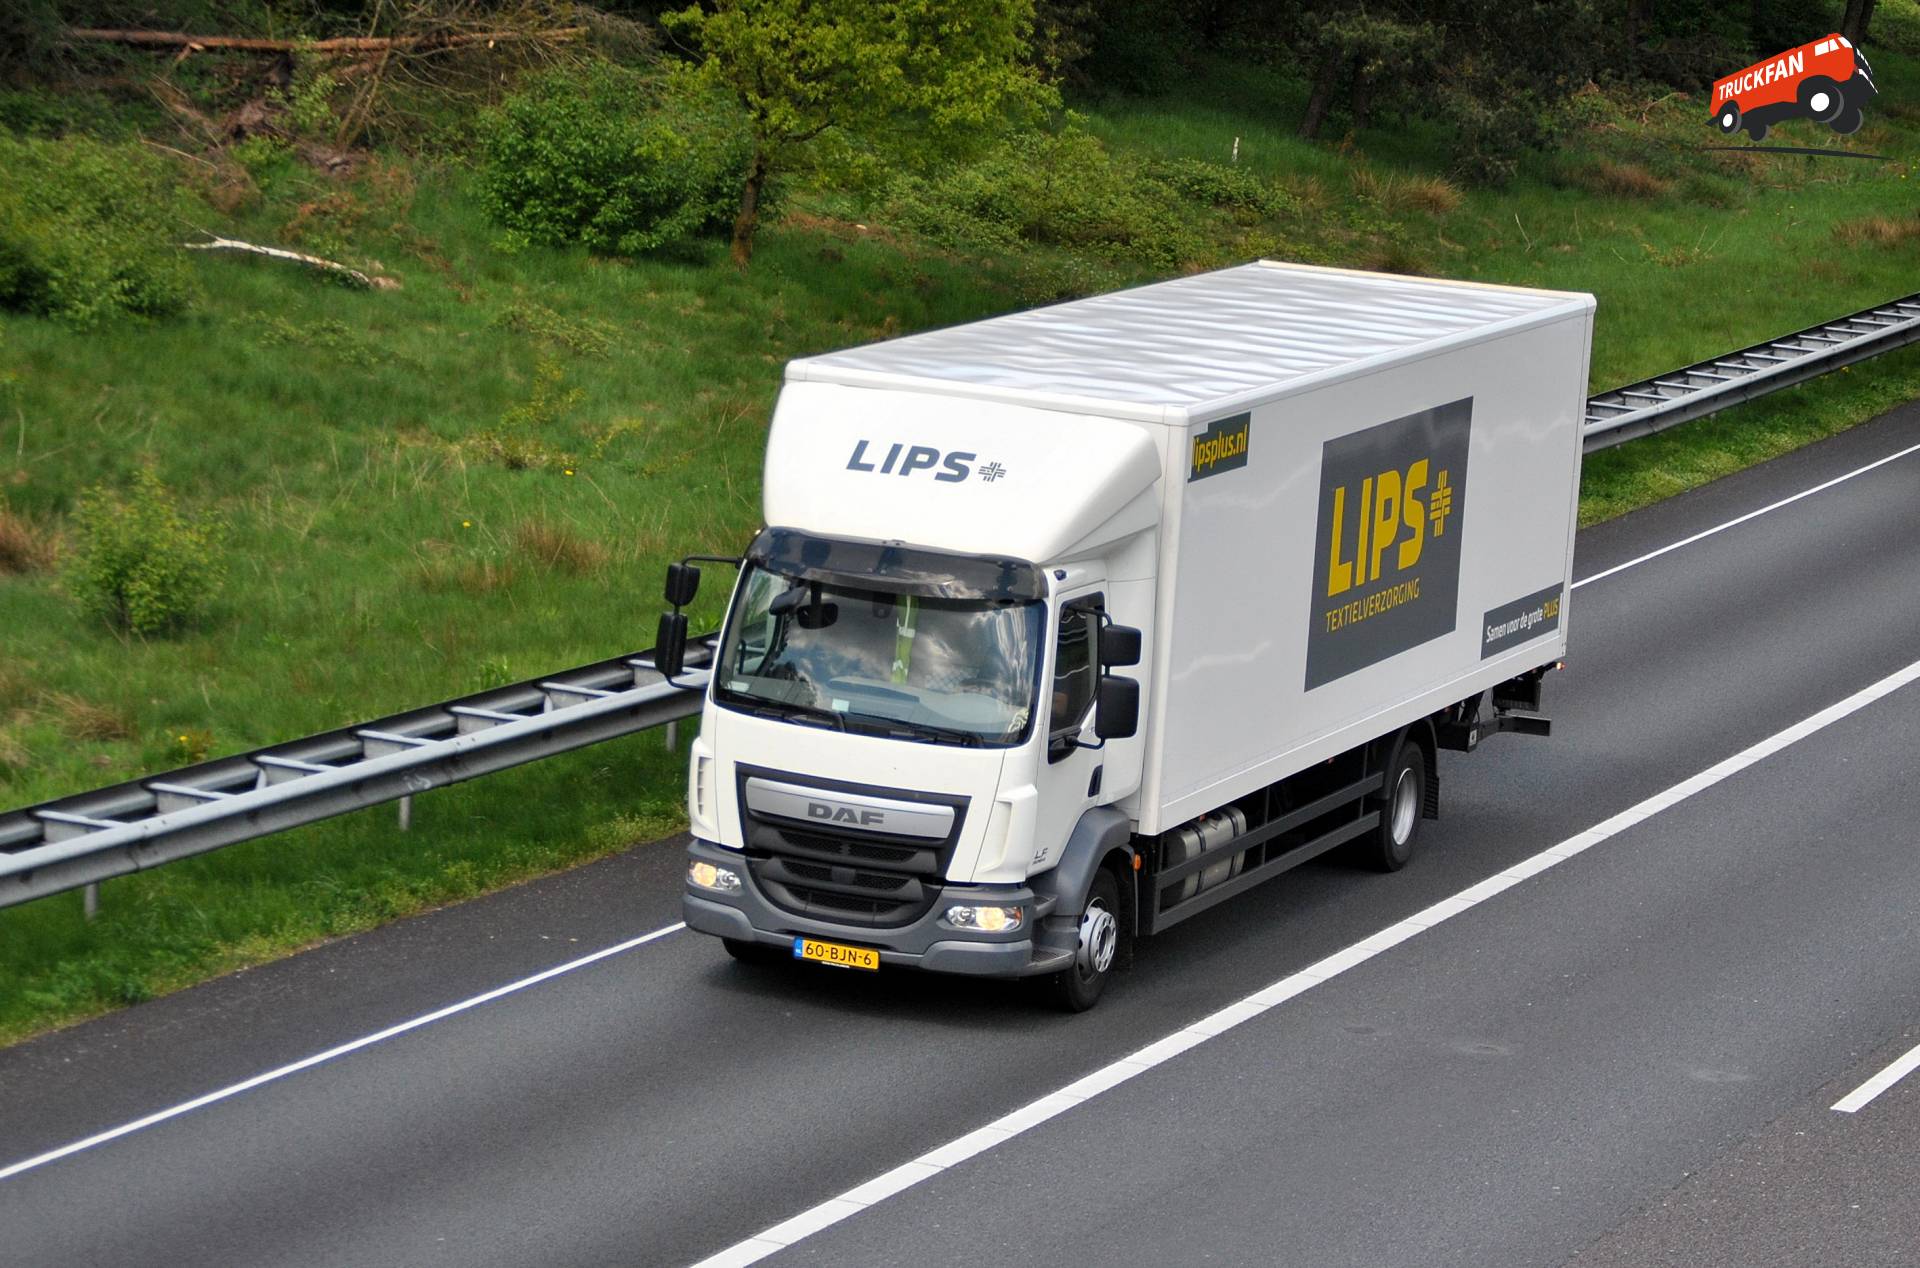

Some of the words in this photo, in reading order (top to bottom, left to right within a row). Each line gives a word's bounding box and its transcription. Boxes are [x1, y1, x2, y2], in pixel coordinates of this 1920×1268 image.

[846, 439, 977, 483] LIPS
[1327, 458, 1429, 597] LIPS
[1326, 577, 1421, 633] TEXTIELVERZORGING
[1486, 623, 1506, 643] Samen
[1506, 617, 1520, 635] voor
[1520, 611, 1528, 629] de
[1527, 607, 1543, 630] grote
[1543, 598, 1559, 620] PLUS
[807, 802, 884, 826] DAF
[804, 942, 873, 966] 60-BJN-6
